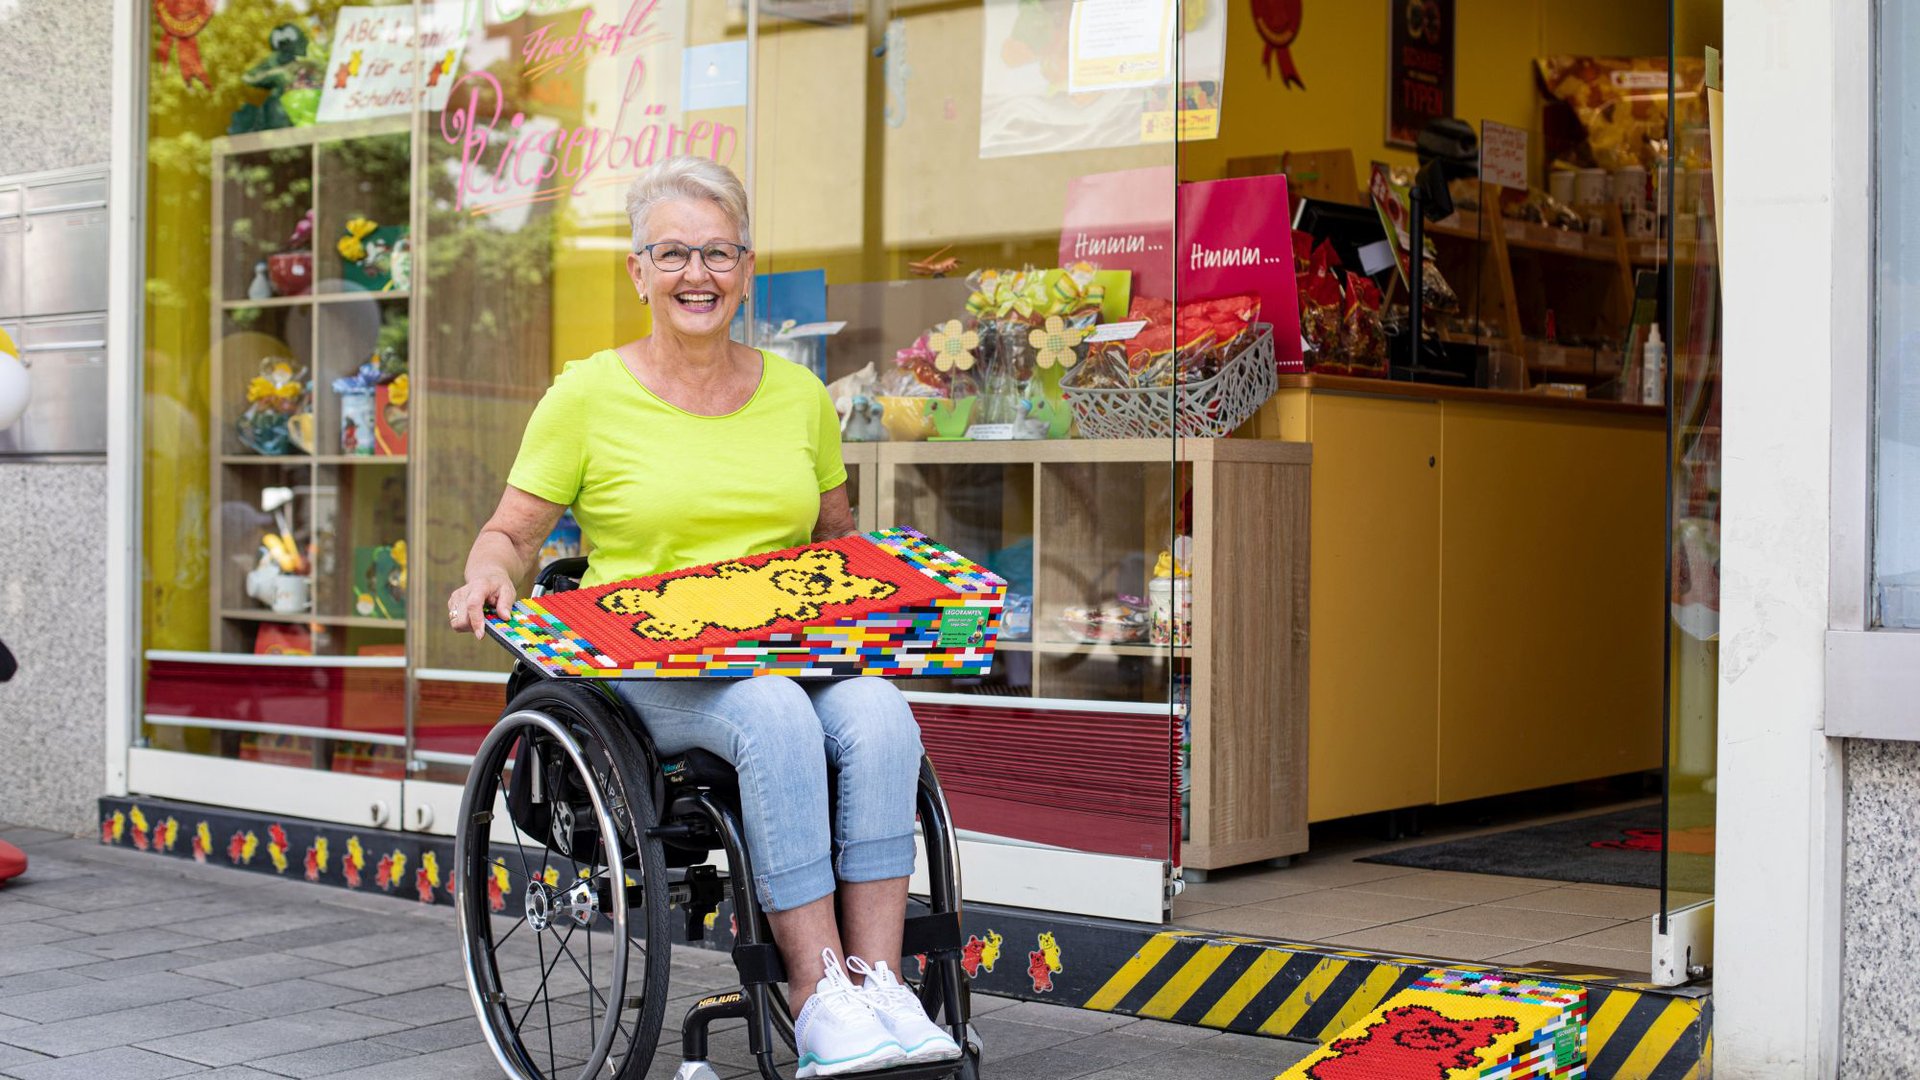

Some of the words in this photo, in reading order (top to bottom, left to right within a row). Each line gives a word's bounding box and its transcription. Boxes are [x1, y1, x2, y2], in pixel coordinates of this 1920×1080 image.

[440, 55, 737, 212] Riesenbären
[1190, 243, 1280, 271] Hmmm...
[698, 992, 740, 1008] HELIUM
